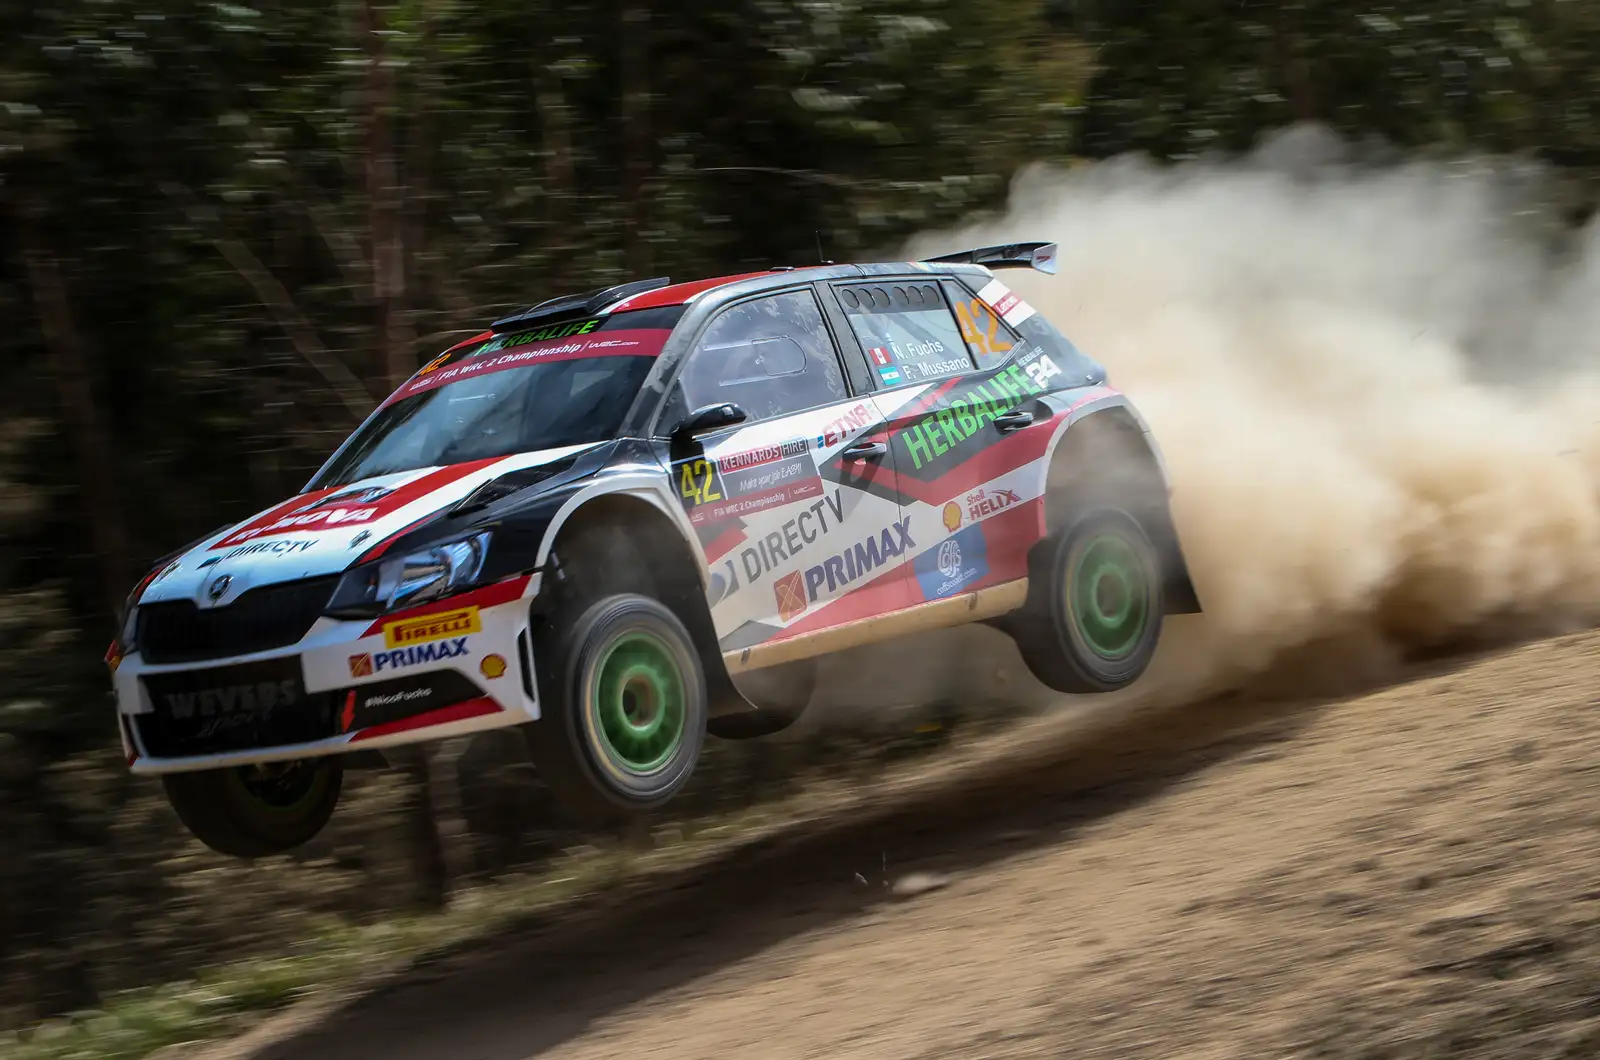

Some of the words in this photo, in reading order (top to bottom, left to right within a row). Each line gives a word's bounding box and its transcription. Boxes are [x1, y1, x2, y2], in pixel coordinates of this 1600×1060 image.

[473, 319, 600, 356] HERBALIFE
[955, 297, 1014, 356] 42
[440, 367, 459, 380] FIA
[460, 361, 484, 374] WRC
[486, 358, 498, 369] 2
[497, 343, 582, 365] Championship
[891, 344, 908, 360] N.
[906, 339, 944, 357] Fuchs
[918, 355, 970, 377] Mussano
[1025, 354, 1064, 390] 24
[821, 404, 874, 448] ETNA
[902, 363, 1043, 470] HERBALIFE
[723, 446, 780, 469] KENNARDS
[782, 441, 806, 456] HIRE
[681, 459, 721, 505] 42
[967, 488, 985, 505] Shell
[744, 492, 785, 512] Championship
[969, 489, 1022, 520] HELIX
[225, 539, 321, 560] DIRECTV
[741, 488, 844, 584] DIRECTV
[804, 515, 917, 602] PRIMAX
[392, 612, 472, 643] PIRELLI
[373, 636, 471, 672] PRIMAX
